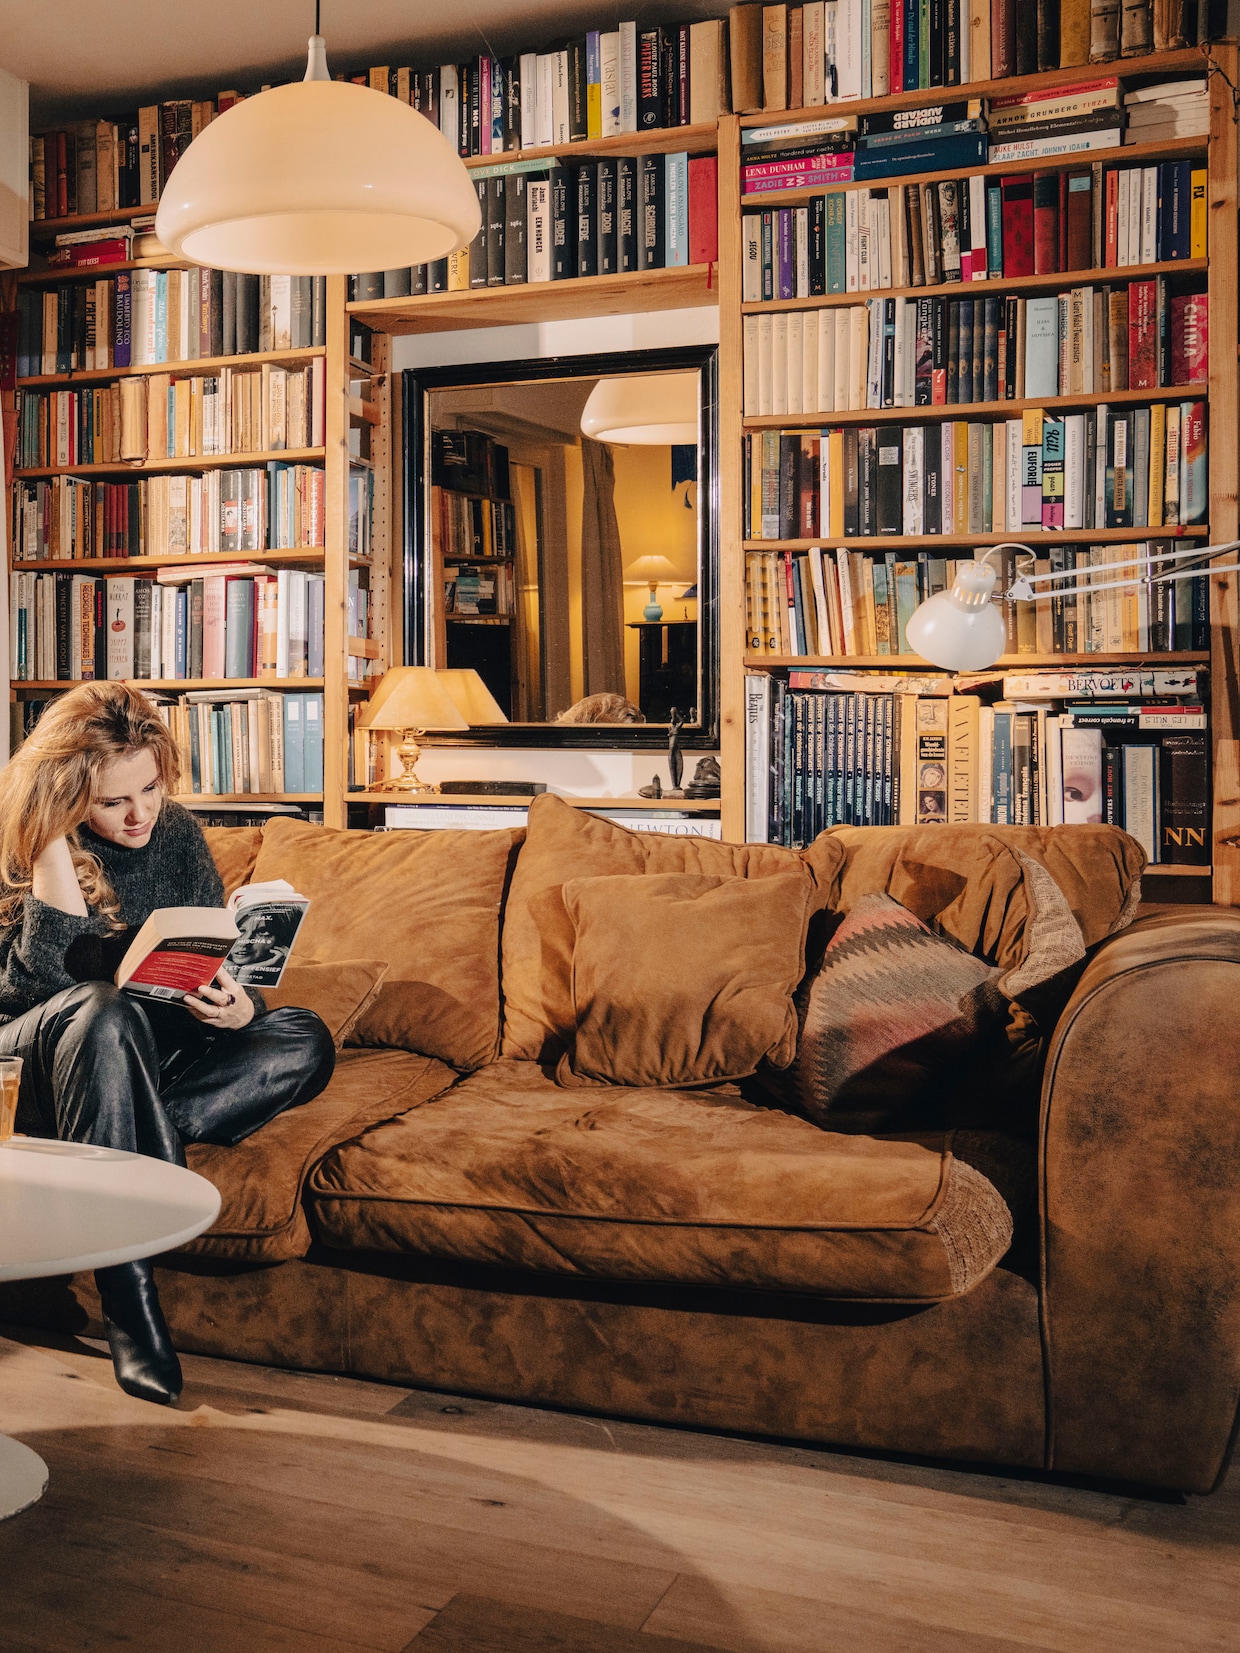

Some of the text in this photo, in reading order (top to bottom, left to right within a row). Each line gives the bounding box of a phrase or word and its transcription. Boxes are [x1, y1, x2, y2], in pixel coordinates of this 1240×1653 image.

[641, 43, 651, 98] PIETER DAENS
[893, 115, 943, 130] AUDIARD
[997, 99, 1107, 124] ARNON GRUNBERG TIRZA
[1014, 142, 1034, 150] HULST
[746, 162, 805, 177] LENA DUNHAM
[755, 172, 838, 190] ZADIE SMITH
[1193, 185, 1205, 199] FLX
[556, 219, 564, 245] VADER
[581, 215, 589, 241] LIEFDE
[603, 212, 611, 234] ZOON
[622, 209, 631, 236] NACHT
[86, 302, 96, 347] PAPILLON
[1184, 304, 1196, 358] CHINA
[1046, 429, 1060, 453] Kill
[1183, 415, 1192, 447] Genovesi
[1192, 420, 1201, 440] Fabio
[1027, 451, 1038, 485] EUFORIE
[1116, 467, 1124, 486] BONITA
[908, 470, 919, 501] SWINGERS
[1048, 476, 1057, 492] your
[1116, 487, 1124, 508] AVENUE
[1068, 677, 1134, 692] BERVOETS
[748, 693, 763, 724] BEATLES
[1164, 827, 1205, 846] NN
